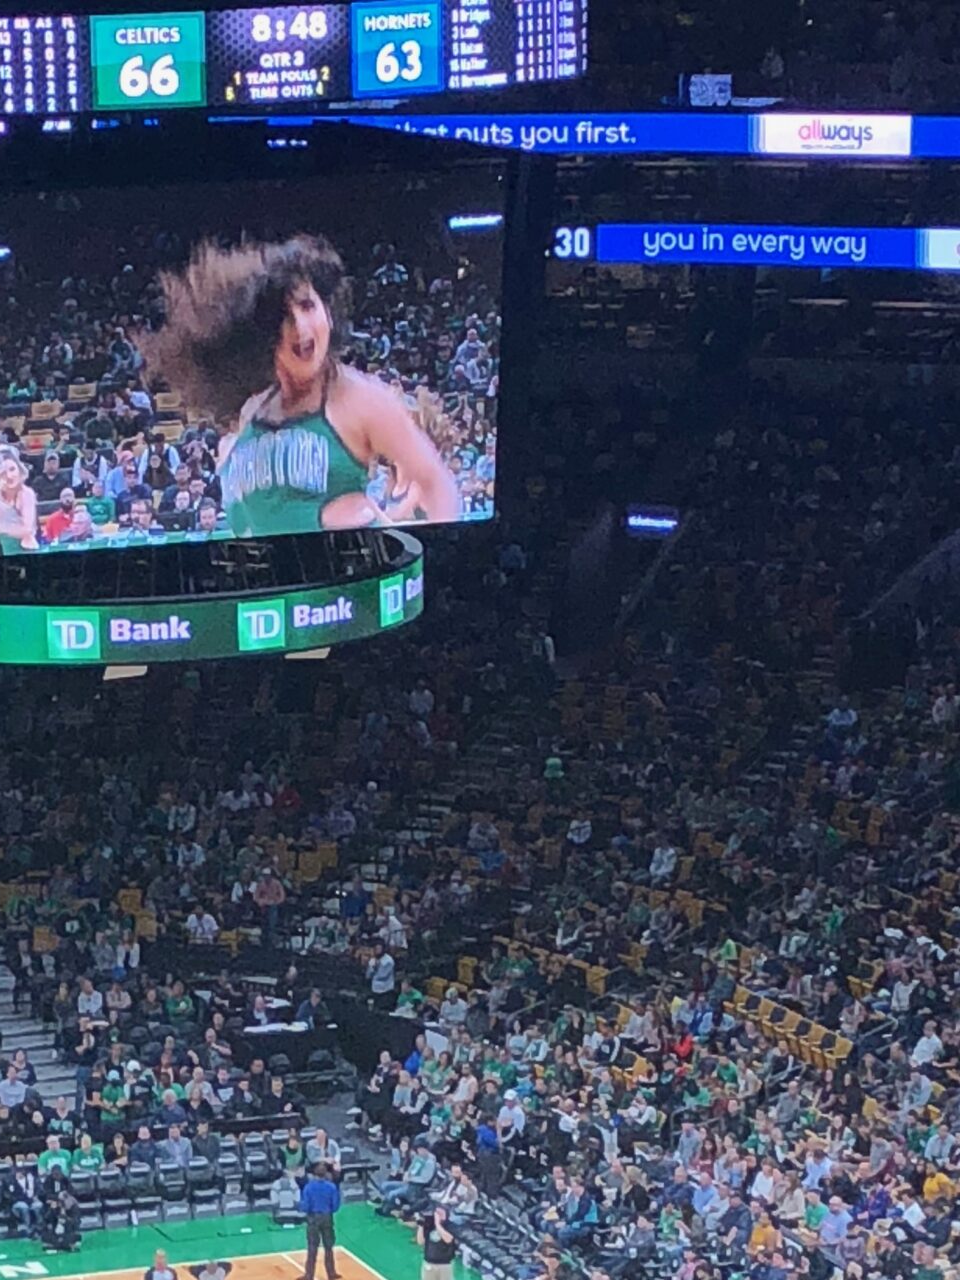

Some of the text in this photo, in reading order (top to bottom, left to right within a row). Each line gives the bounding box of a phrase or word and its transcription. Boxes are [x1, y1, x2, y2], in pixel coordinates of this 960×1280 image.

[36, 18, 52, 28] AS
[251, 11, 327, 42] 8:48
[364, 12, 432, 32] HORNETS
[115, 27, 180, 45] CELTICS
[24, 48, 32, 62] 5
[67, 47, 75, 60] 4
[259, 50, 304, 68] QTR 3
[376, 40, 422, 83] 63
[0, 66, 12, 79] 12
[25, 65, 33, 79] 2
[47, 64, 55, 78] 2
[68, 64, 76, 78] 2
[119, 54, 180, 97] 66
[234, 72, 241, 85] 1
[245, 71, 278, 85] TEAM
[321, 66, 330, 81] 2
[5, 82, 13, 96] 4
[25, 82, 33, 95] 4
[250, 87, 278, 99] TIME
[281, 85, 313, 98] OUTS
[48, 98, 55, 111] 2
[70, 98, 77, 111] 1
[520, 125, 569, 150] you
[575, 120, 637, 144] first.
[798, 119, 874, 150] allways
[643, 227, 867, 262] you in every way
[384, 584, 402, 615] TD
[243, 596, 353, 640] TD Bank
[52, 616, 190, 651] TD Bank
